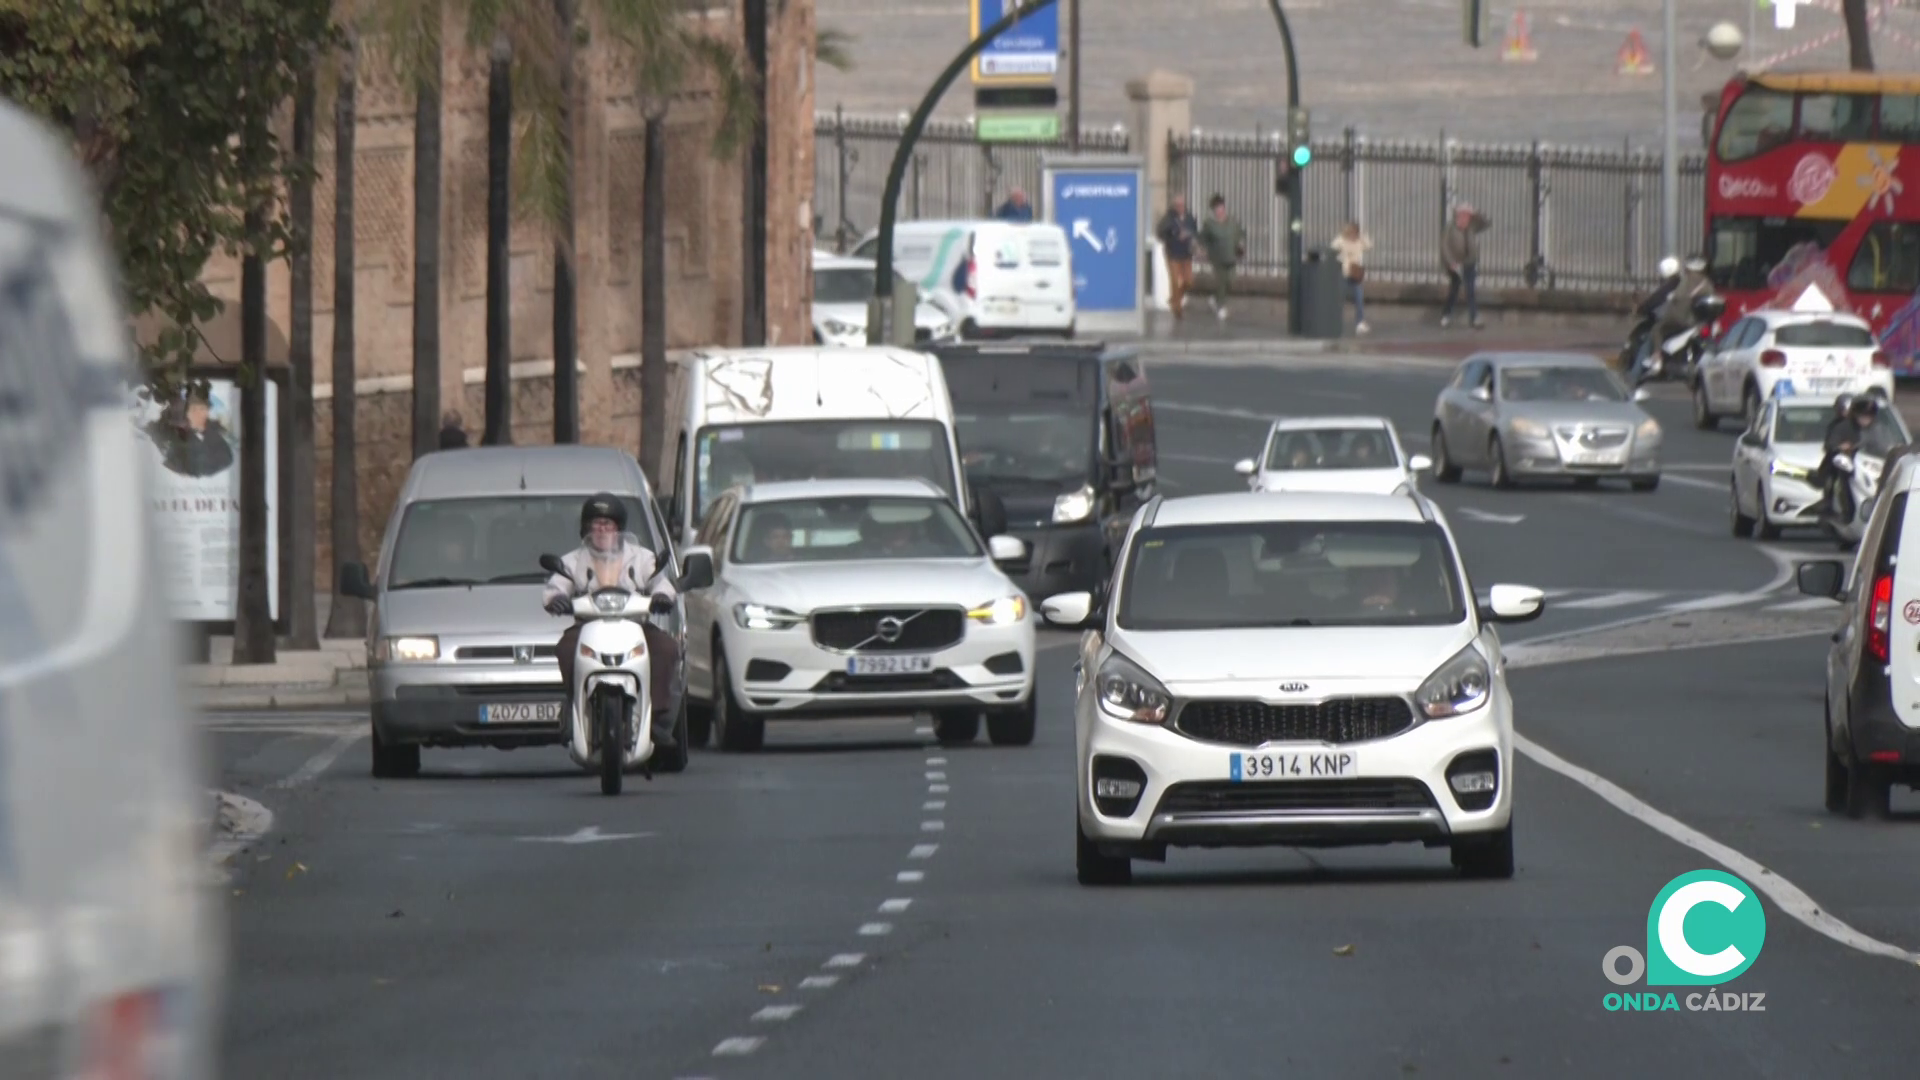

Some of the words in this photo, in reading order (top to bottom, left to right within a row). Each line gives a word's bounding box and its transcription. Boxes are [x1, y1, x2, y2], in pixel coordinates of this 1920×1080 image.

[491, 704, 531, 719] 4070
[1247, 755, 1301, 776] 3914
[1309, 754, 1351, 775] KNP
